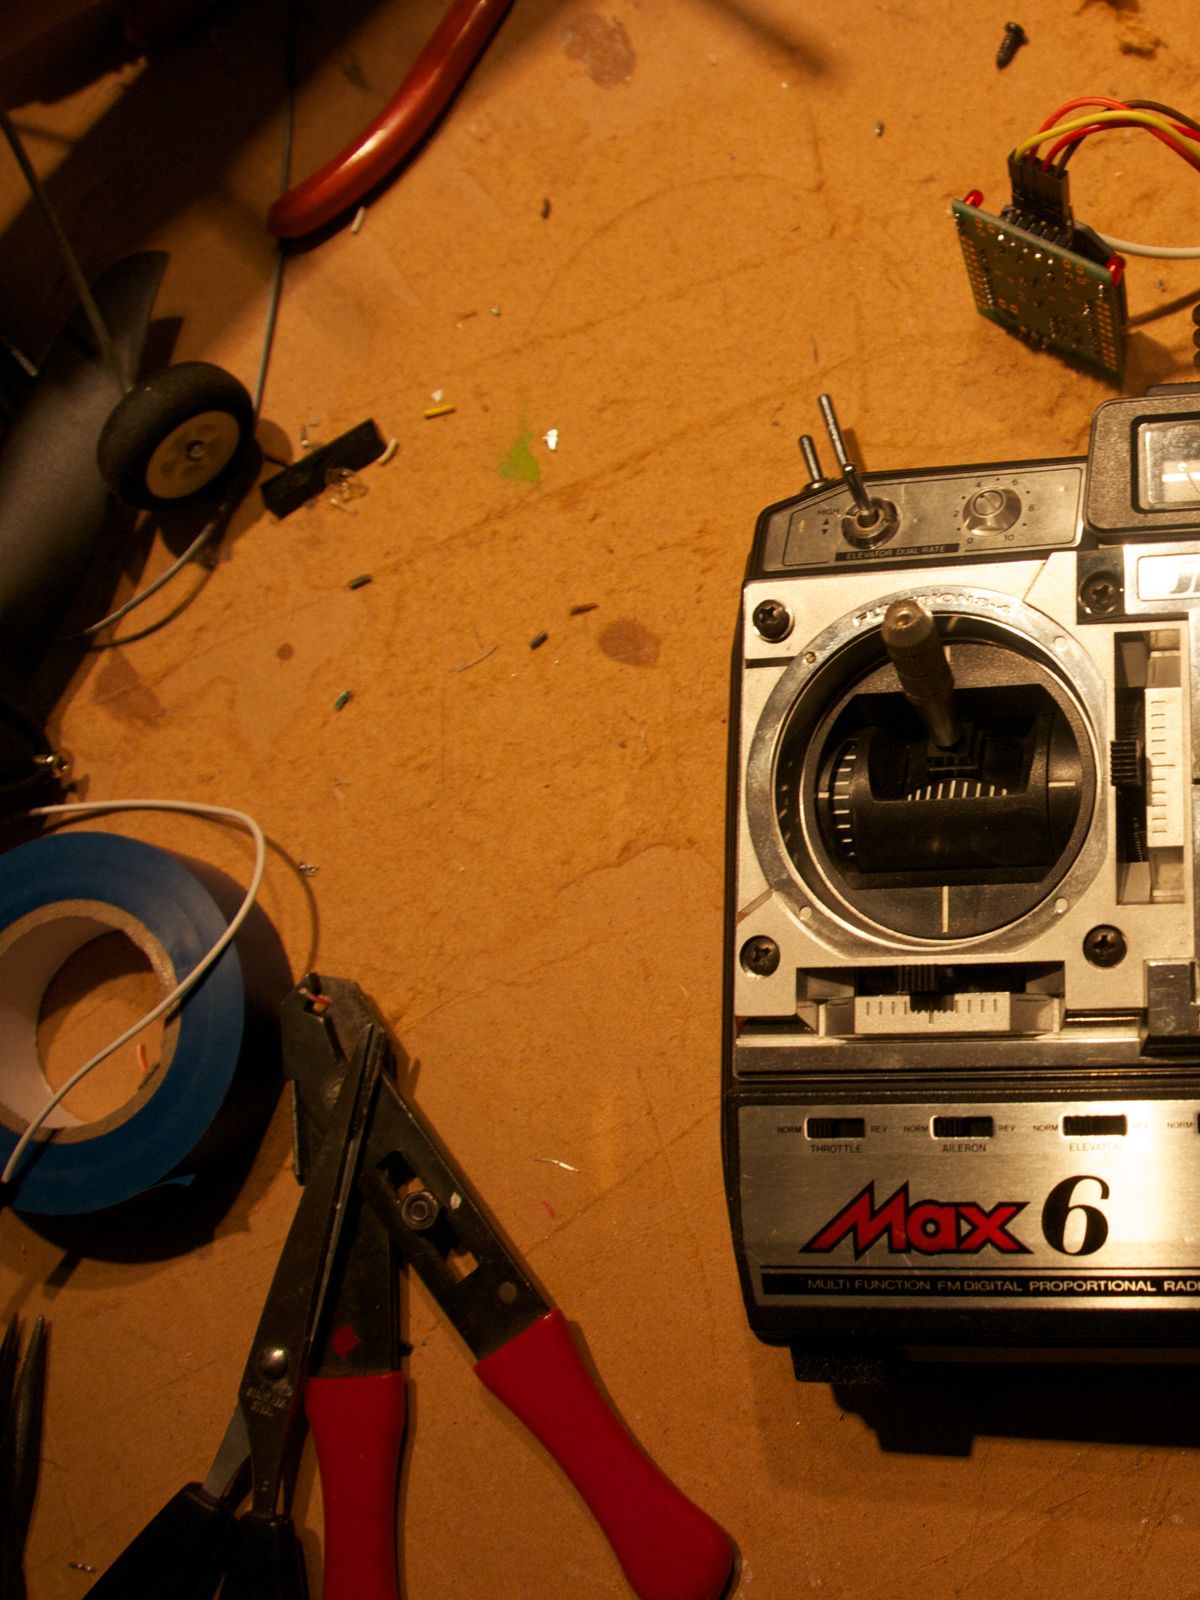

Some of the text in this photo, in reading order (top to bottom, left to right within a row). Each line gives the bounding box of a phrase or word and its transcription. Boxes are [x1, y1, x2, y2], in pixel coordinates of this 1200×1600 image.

[846, 544, 946, 560] ELEVATOR DUAL RATE
[904, 1125, 929, 1133] NORM
[1033, 1124, 1058, 1132] NORM
[810, 1144, 863, 1153] THROTTLE
[942, 1144, 986, 1152] AILERON
[800, 1175, 1110, 1261] Max 6
[808, 1279, 850, 1290] MULTI
[854, 1279, 932, 1291] FUNCTION
[937, 1280, 961, 1291] FM
[964, 1280, 1023, 1292] DIGITAL
[1028, 1280, 1157, 1292] PROPORTIONAL
